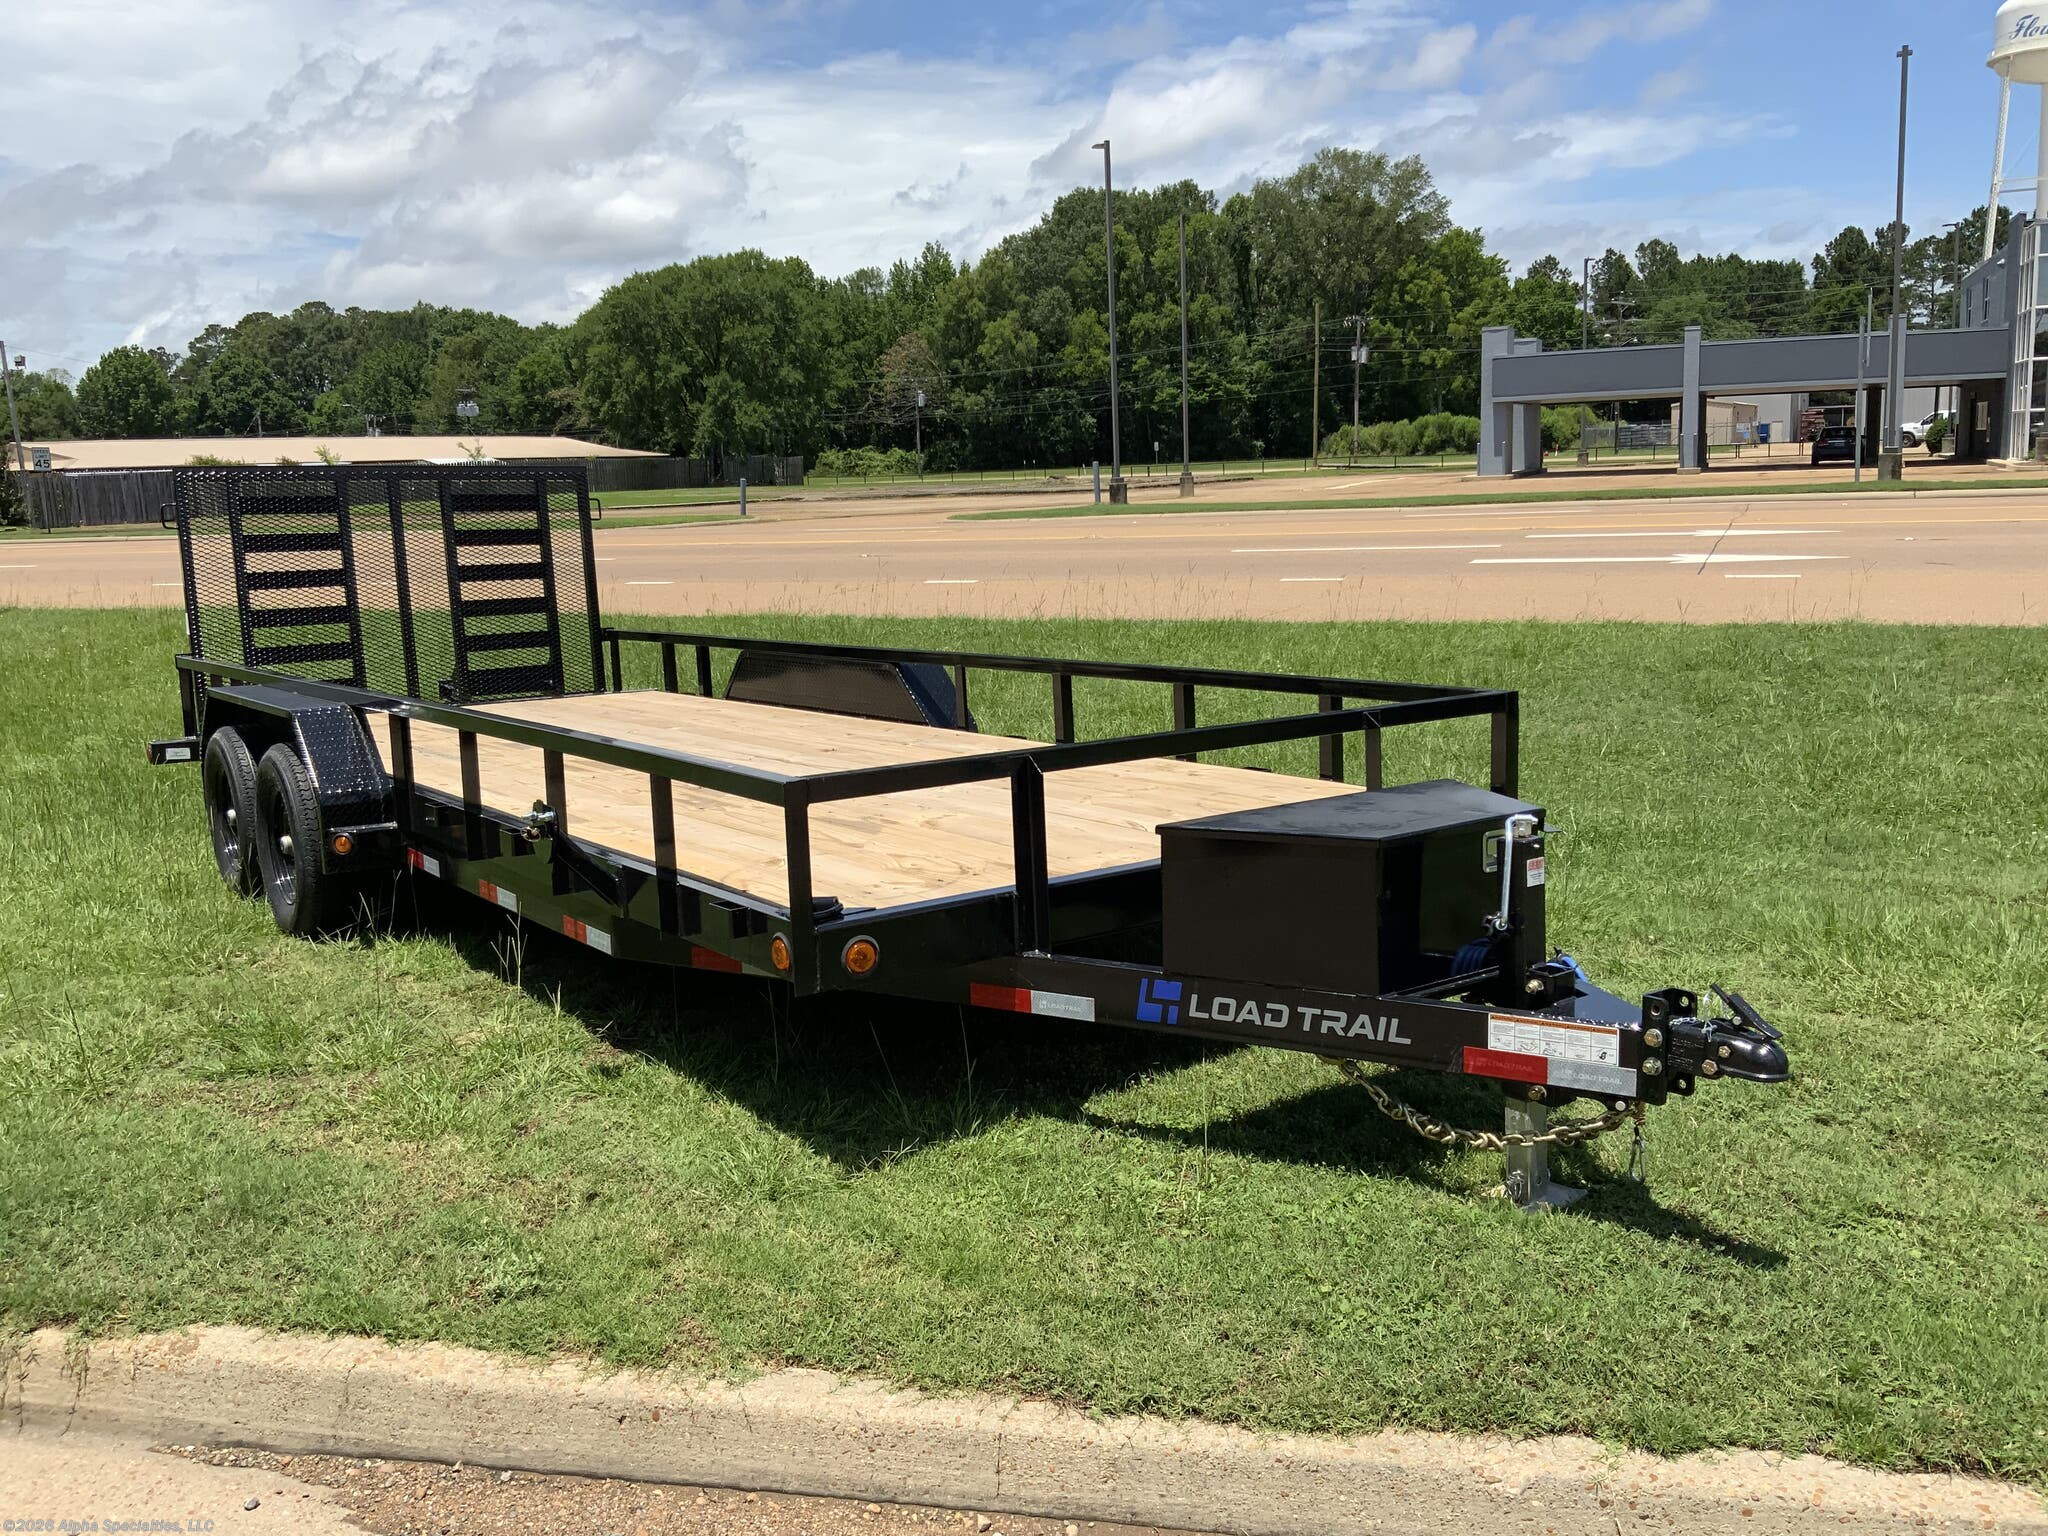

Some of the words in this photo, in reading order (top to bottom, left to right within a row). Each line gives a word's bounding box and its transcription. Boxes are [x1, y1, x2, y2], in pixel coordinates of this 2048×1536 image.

[35, 459, 50, 468] 45
[1188, 993, 1290, 1029] LOAD
[1297, 1006, 1412, 1045] TRAIL
